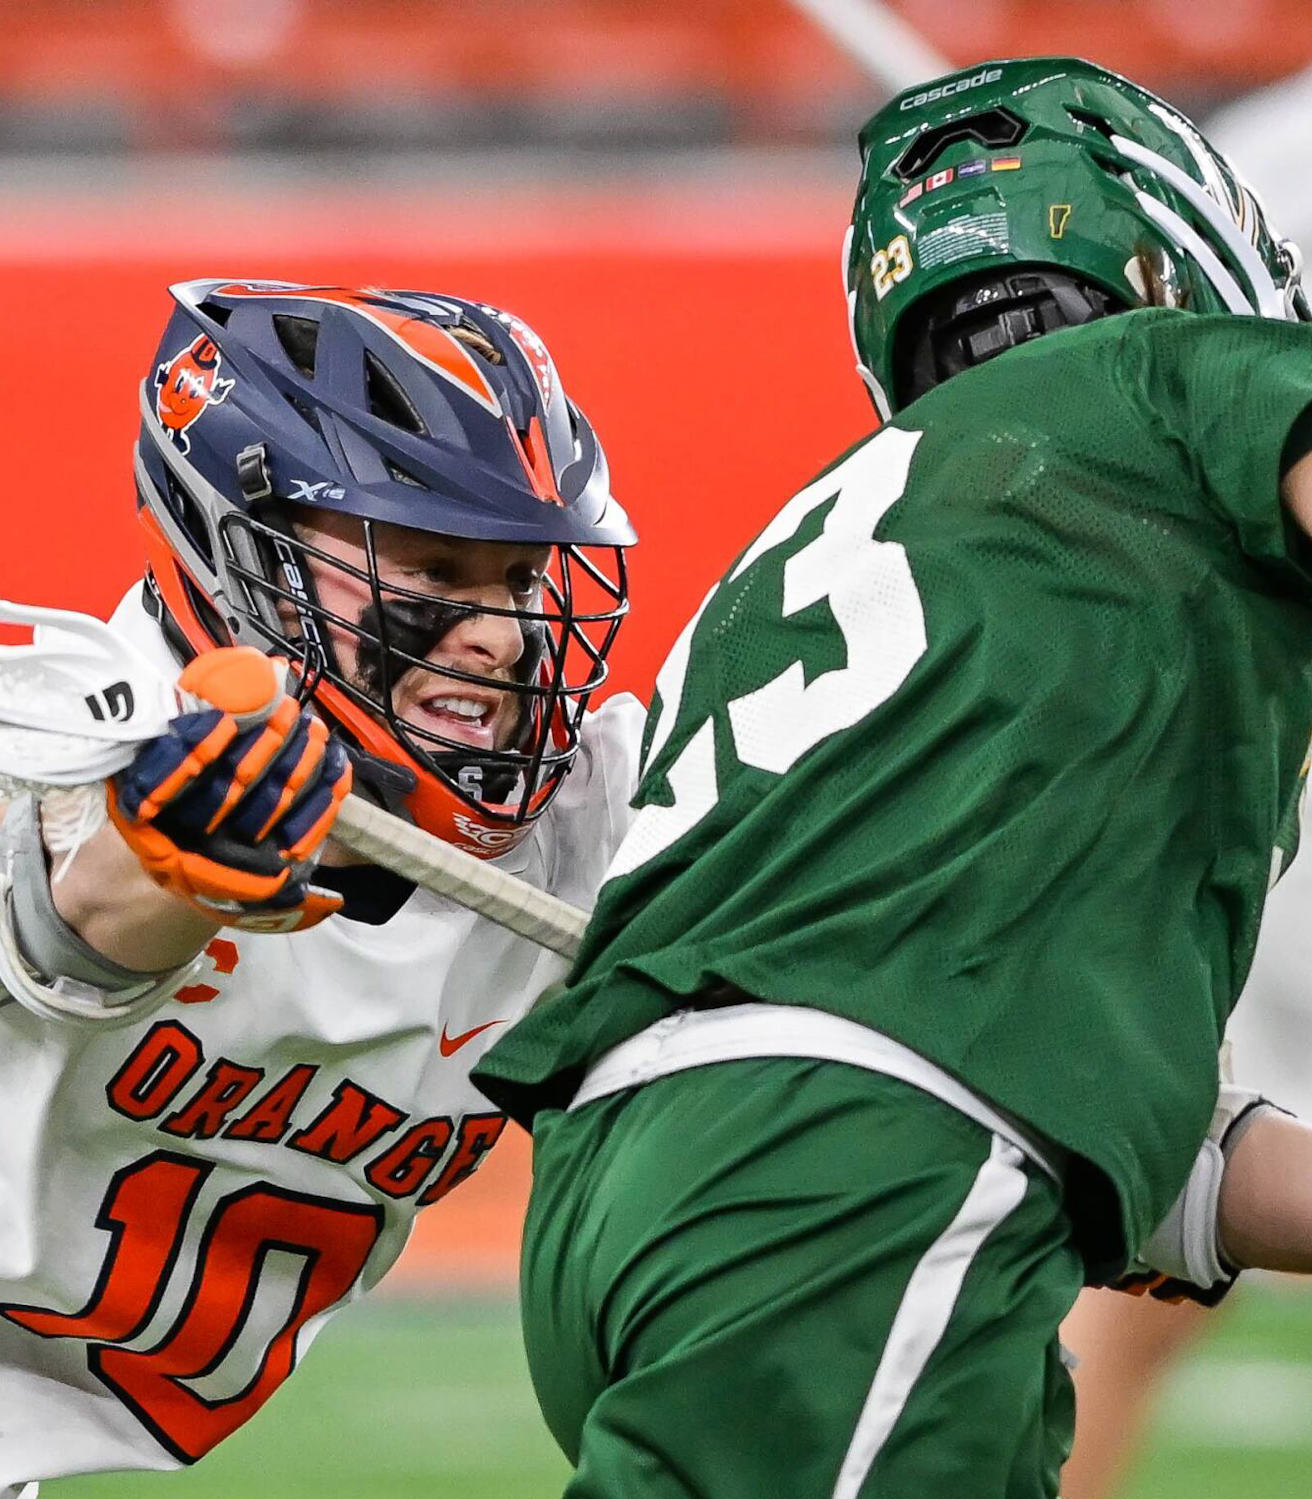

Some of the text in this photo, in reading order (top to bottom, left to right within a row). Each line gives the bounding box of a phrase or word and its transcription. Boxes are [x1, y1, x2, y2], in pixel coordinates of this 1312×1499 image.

[899, 68, 1003, 111] cascade
[870, 234, 914, 302] 23
[105, 1018, 510, 1207] ORANGE
